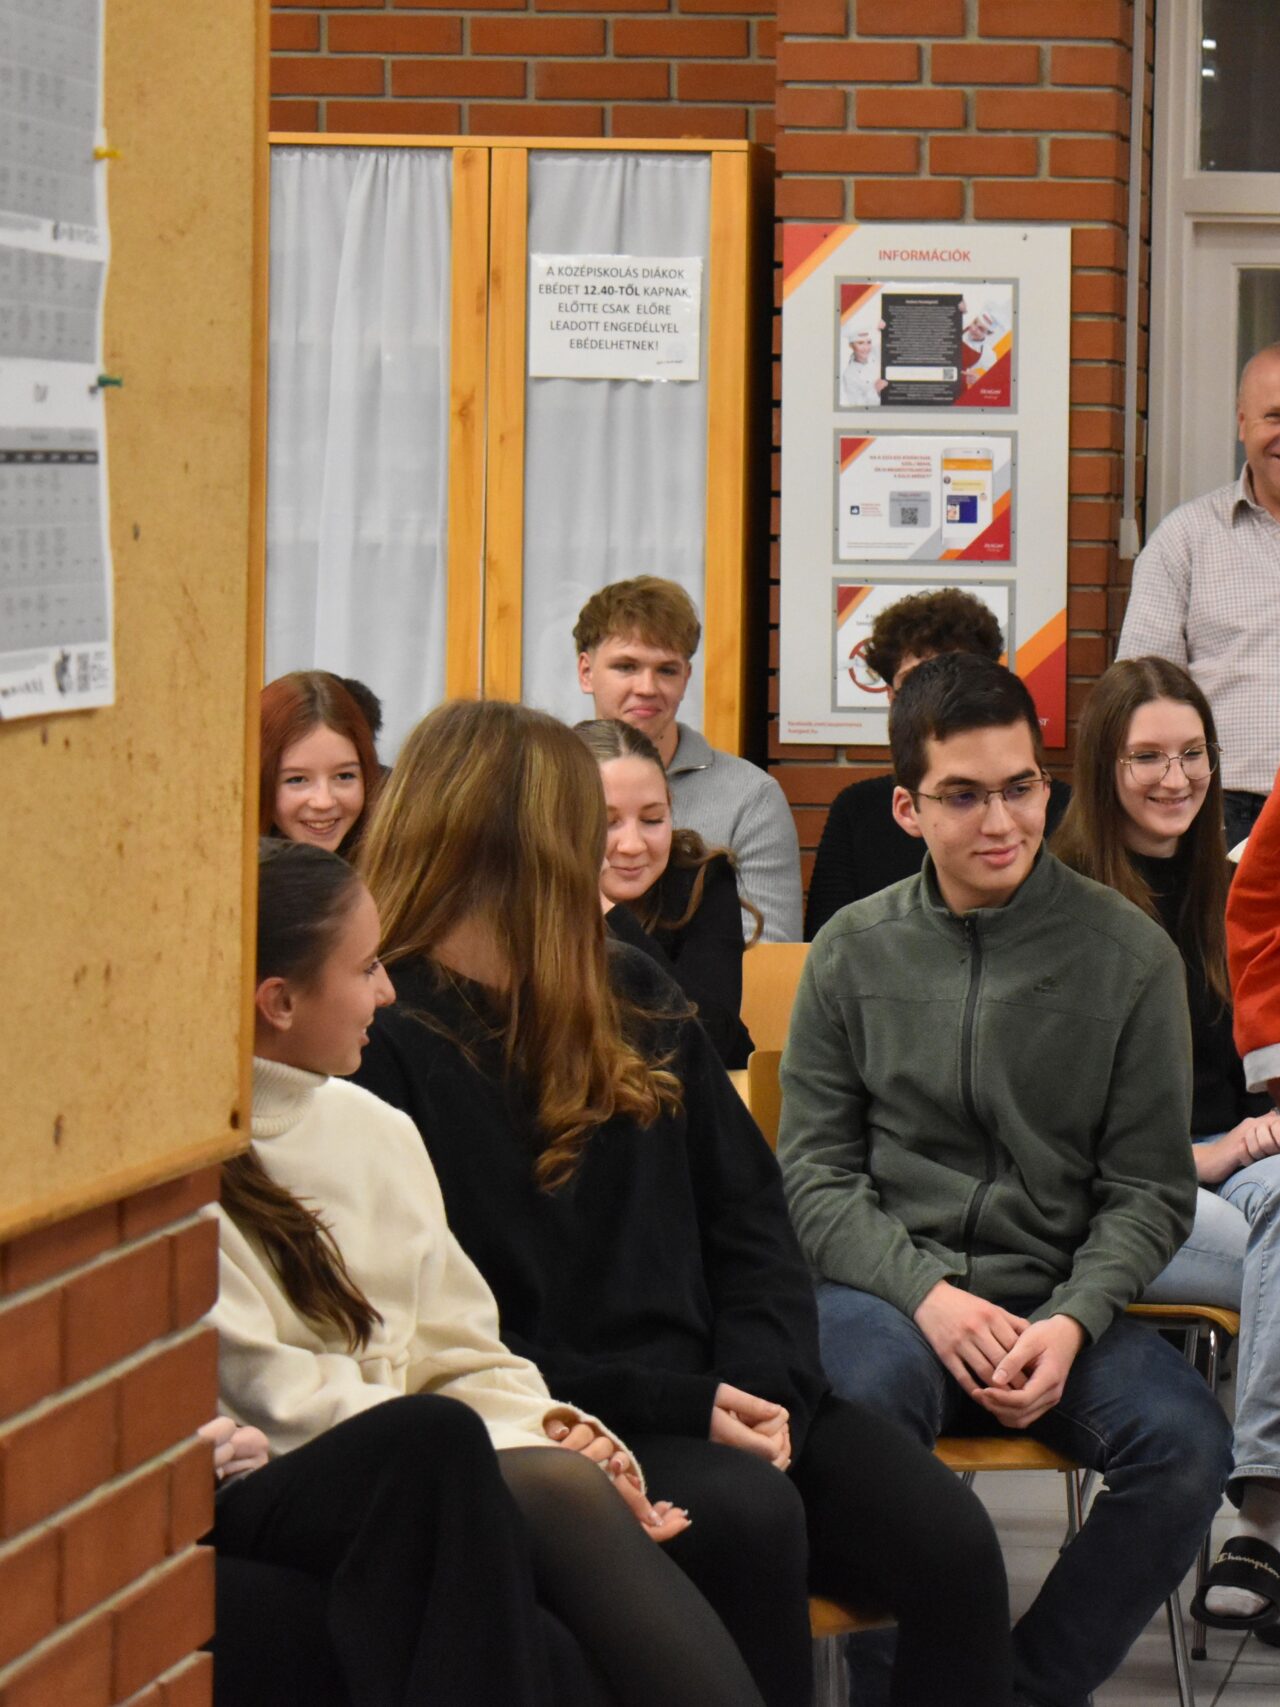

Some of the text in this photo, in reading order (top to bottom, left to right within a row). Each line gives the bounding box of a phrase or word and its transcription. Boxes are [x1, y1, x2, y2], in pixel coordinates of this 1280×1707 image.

[879, 249, 971, 262] INFORMÁCIÓK
[546, 266, 555, 277] A
[642, 267, 685, 279] DIÁKOK
[538, 284, 580, 295] EBÉDET
[584, 284, 640, 296] 12.40-TŐL
[558, 302, 672, 315] ELŐTTE CSAK ELŐRE
[550, 320, 680, 333] LEADOTT ENGEDÉLLYEL
[569, 338, 659, 351] EBÉDELHETNEK!
[1215, 1552, 1280, 1579] Champion
